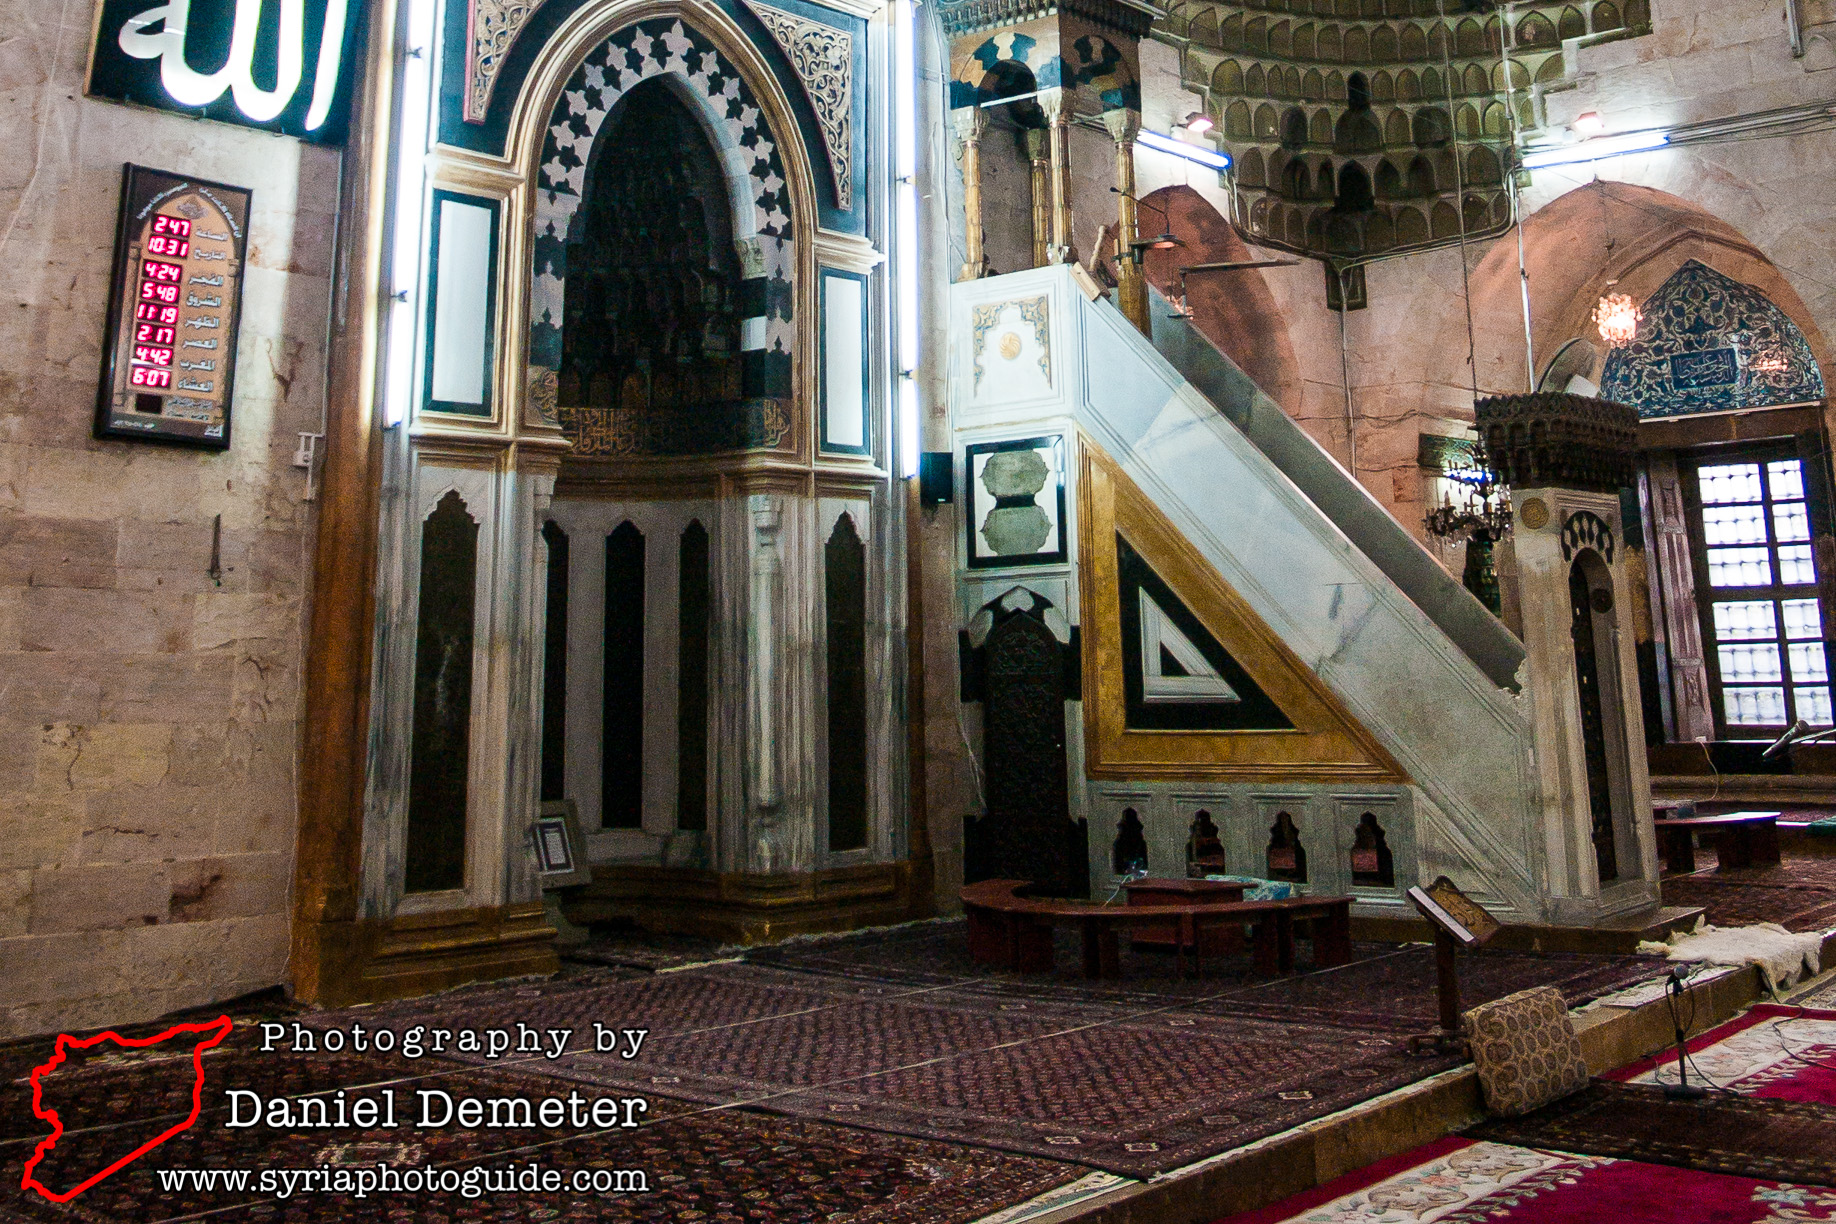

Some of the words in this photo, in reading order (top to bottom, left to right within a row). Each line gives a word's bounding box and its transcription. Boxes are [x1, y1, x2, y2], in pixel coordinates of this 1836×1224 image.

[189, 273, 224, 287] الفجر
[186, 291, 222, 308] الشروق
[184, 316, 220, 330] الظهر
[182, 338, 218, 350] العصر
